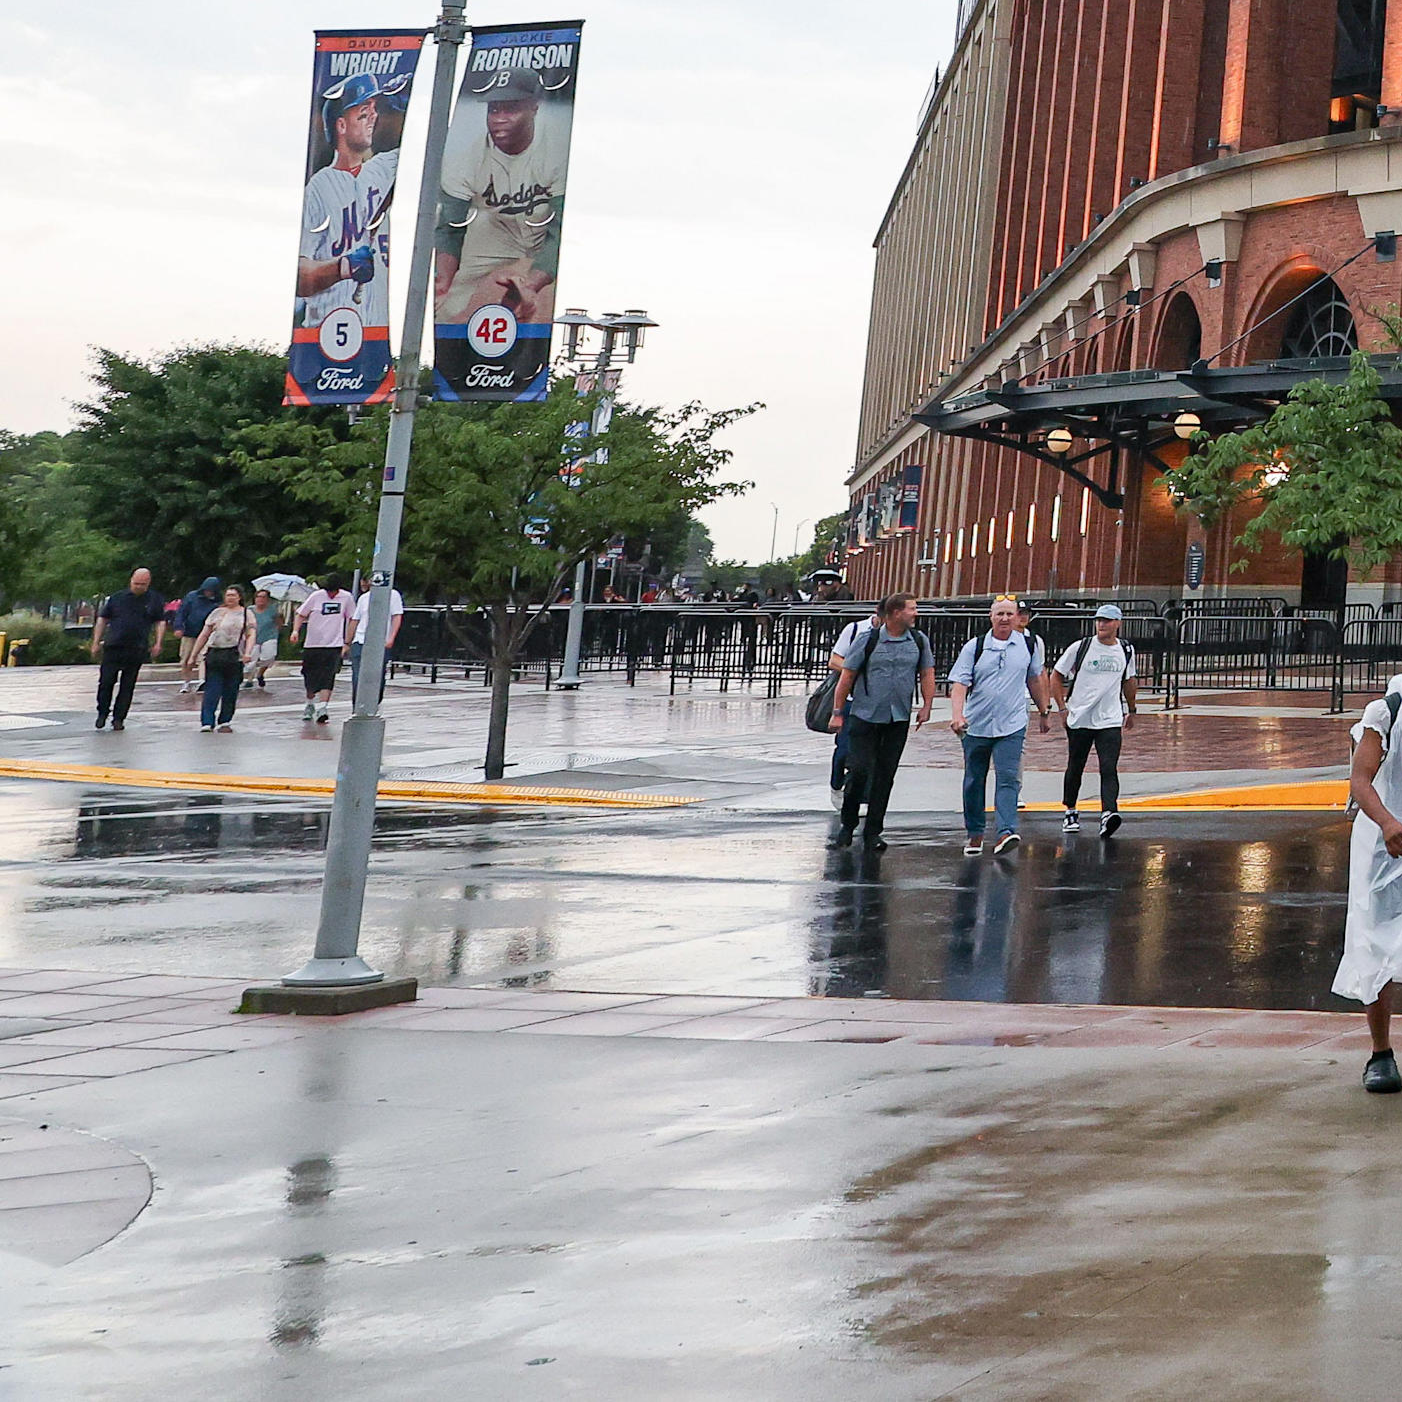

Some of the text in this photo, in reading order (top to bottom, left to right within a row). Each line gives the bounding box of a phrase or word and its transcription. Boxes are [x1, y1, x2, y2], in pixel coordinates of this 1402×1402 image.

[348, 38, 391, 48] DAVID
[501, 32, 553, 44] JACKIE
[330, 51, 403, 76] WRIGHT
[472, 44, 573, 72] ROBINSON
[497, 71, 511, 88] B
[336, 323, 348, 347] 5
[476, 318, 507, 343] 42
[317, 367, 364, 391] Ford
[466, 364, 515, 388] Ford
